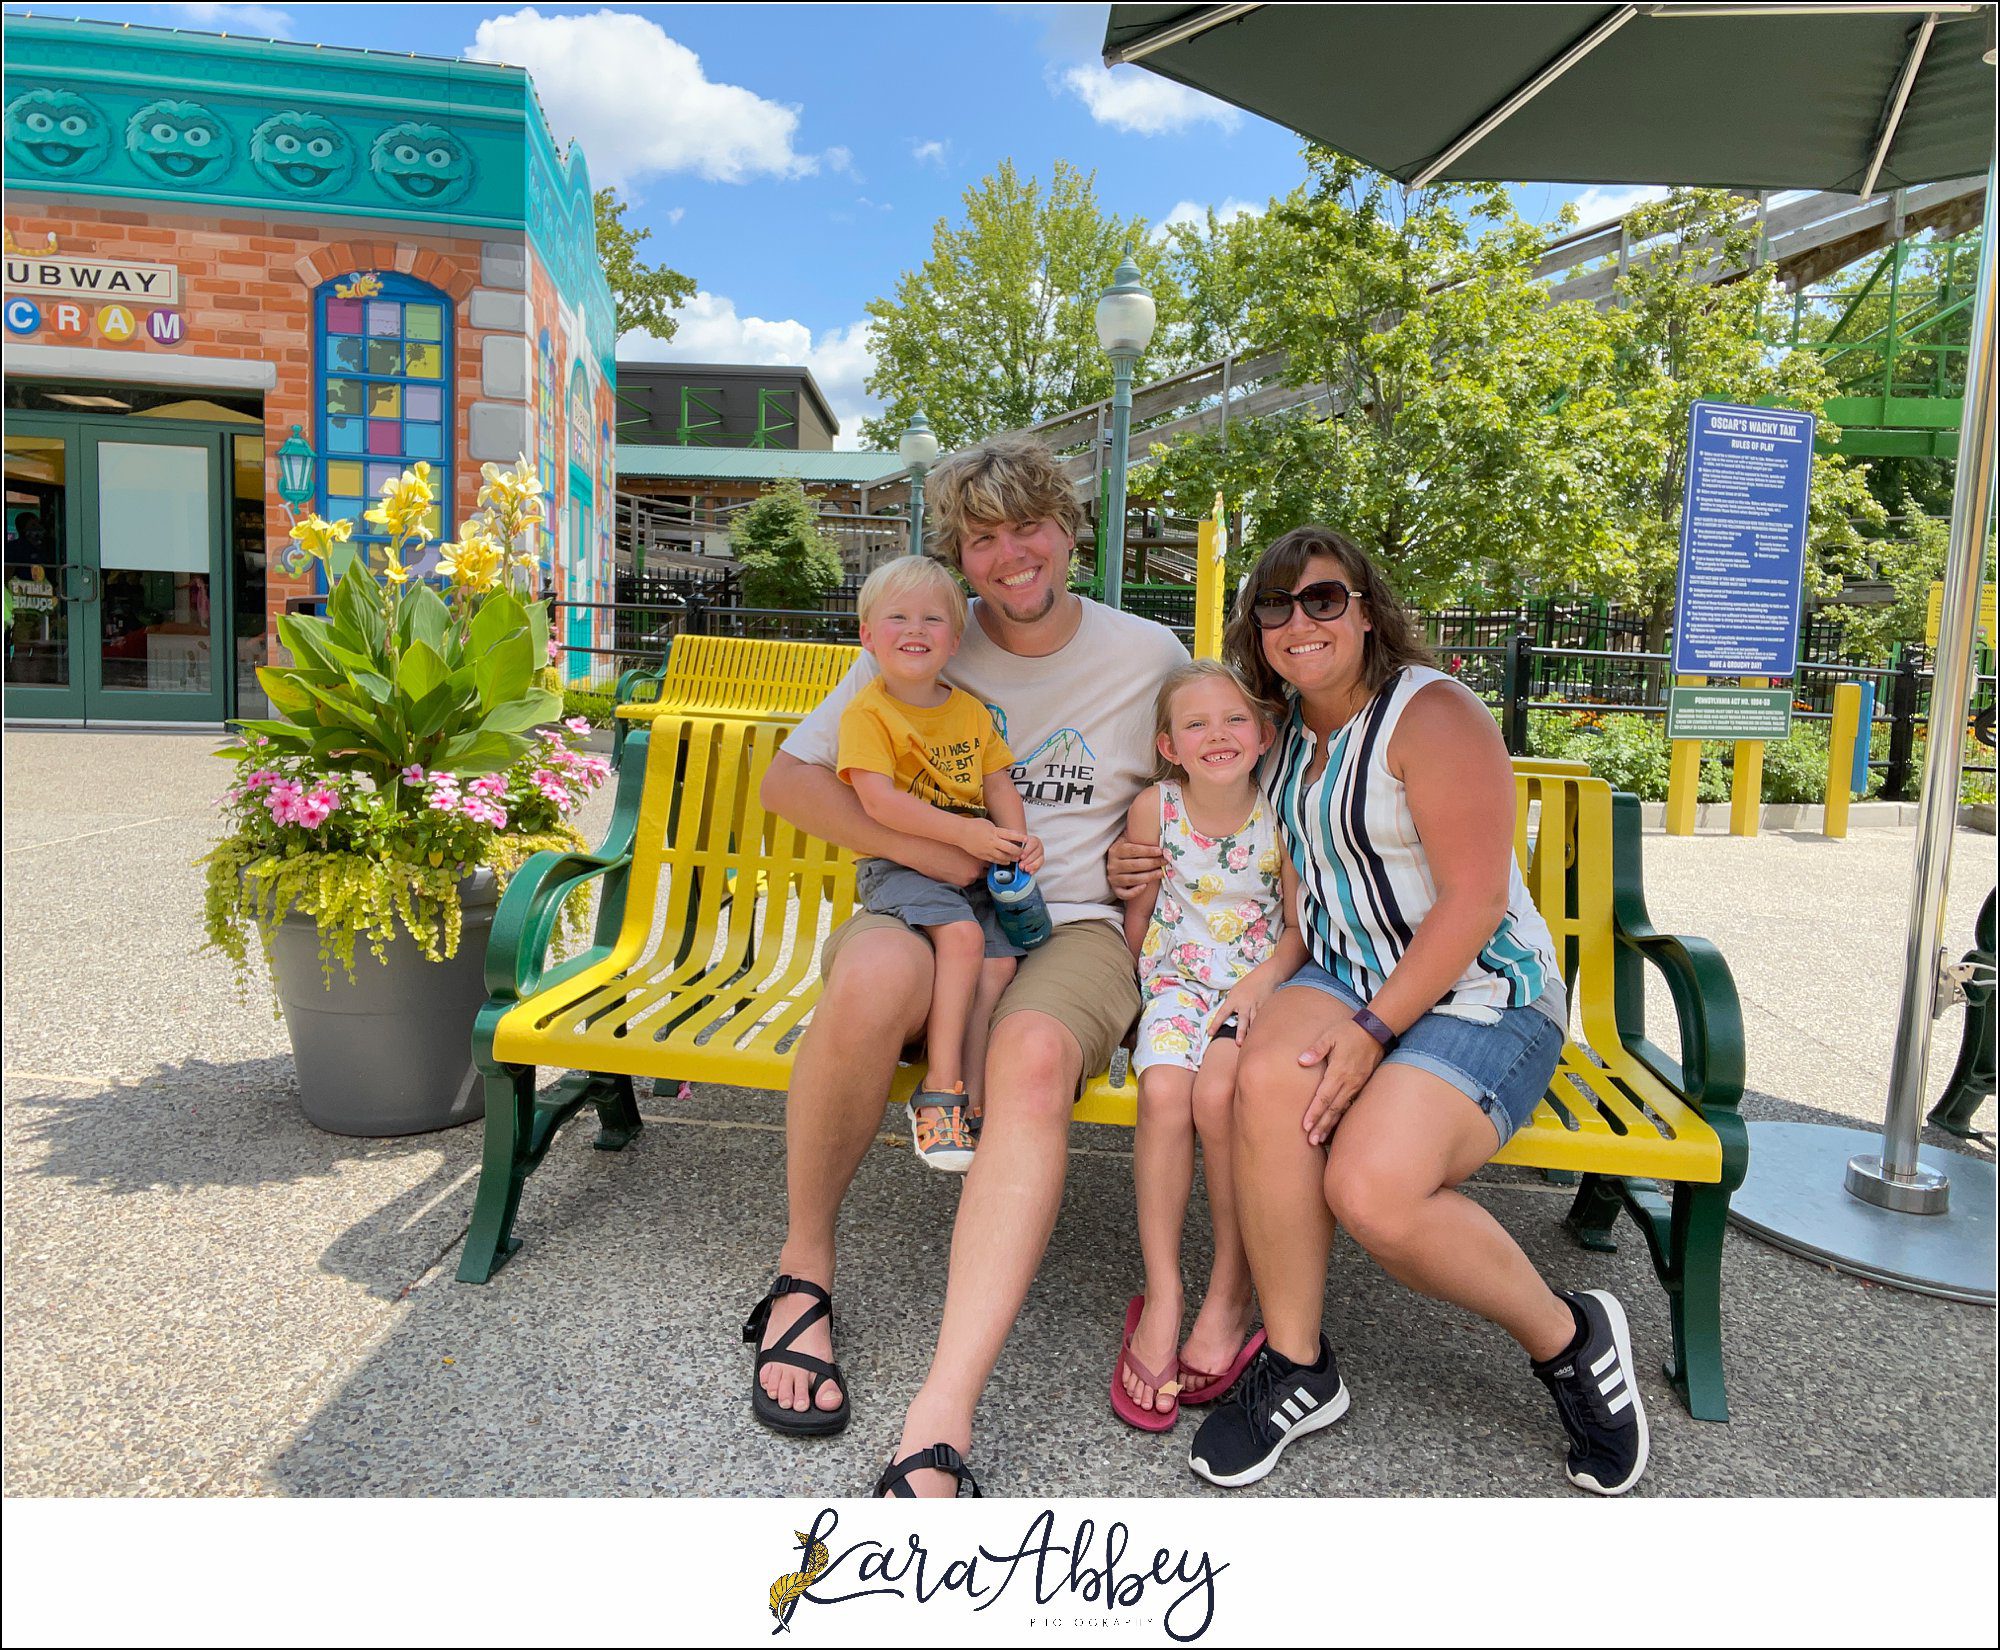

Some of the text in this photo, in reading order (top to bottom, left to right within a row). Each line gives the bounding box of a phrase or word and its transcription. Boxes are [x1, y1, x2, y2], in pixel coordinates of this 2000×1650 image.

[1711, 417, 1797, 437] OSCAR'S WACKY TAXI
[1731, 439, 1775, 452] RULES OF PLAY
[1727, 661, 1750, 669] GROUCHY
[1694, 696, 1731, 705] PENNSYLVANIA
[1730, 697, 1741, 705] ACT
[948, 741, 971, 757] WAS
[956, 753, 975, 770] BIT
[1006, 764, 1095, 780] O THE
[1013, 781, 1095, 805] OOM
